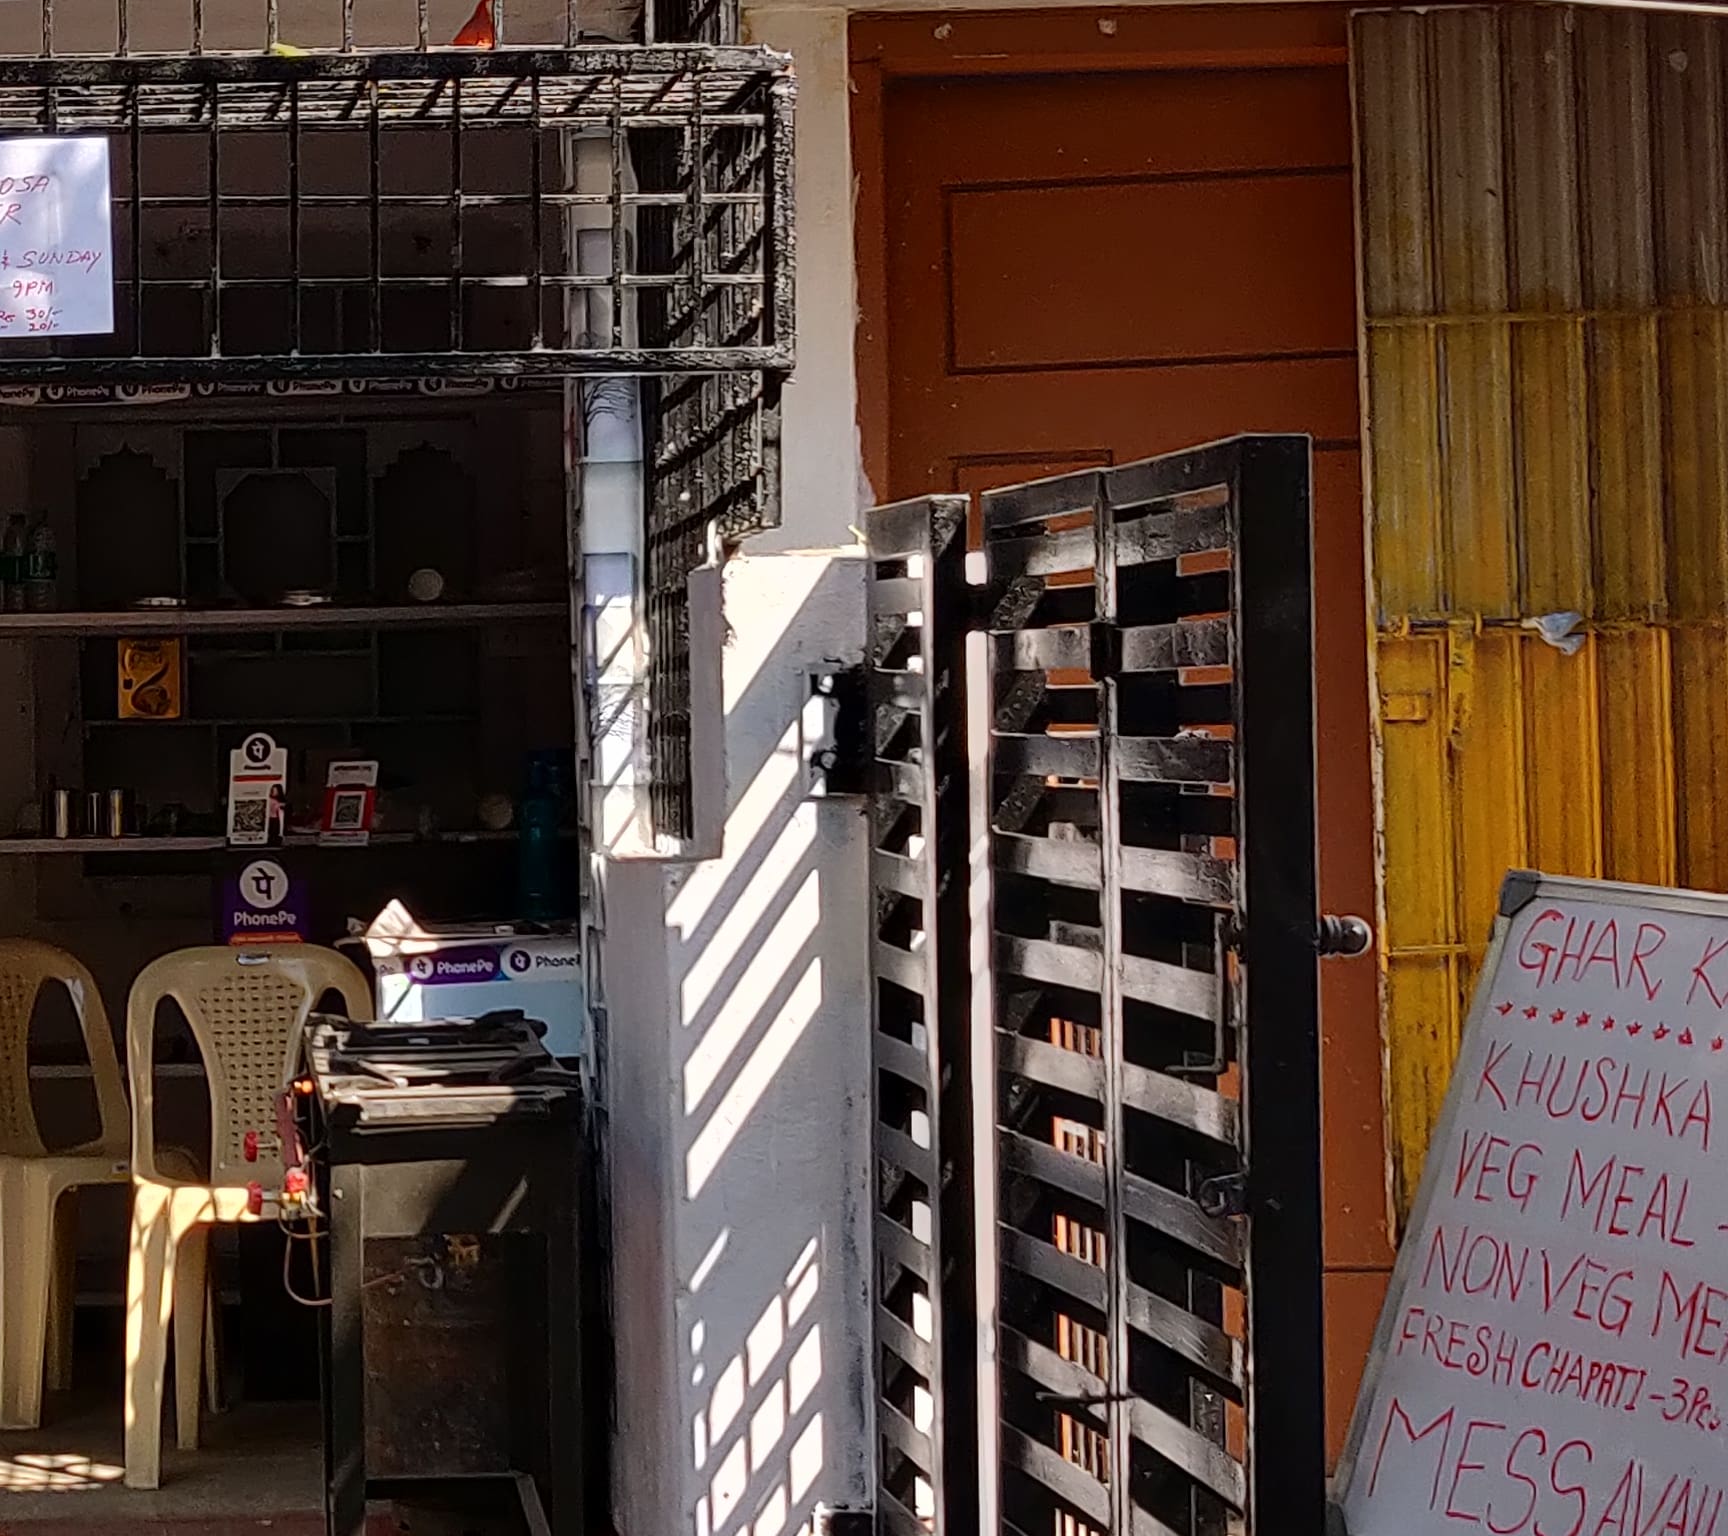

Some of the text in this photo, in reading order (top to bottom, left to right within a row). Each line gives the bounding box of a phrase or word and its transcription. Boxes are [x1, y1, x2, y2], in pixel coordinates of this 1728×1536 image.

[16, 249, 102, 273] SUNDAY
[233, 910, 297, 926] PhonePe
[1518, 908, 1728, 1009] GHAR K
[436, 959, 494, 975] PhonePe
[1474, 1039, 1712, 1153] KHUSHKA
[1453, 1129, 1544, 1214] VEG
[1560, 1148, 1696, 1247] MEAL
[1396, 1307, 1519, 1386] FRESH
[1650, 1270, 1728, 1366] ME
